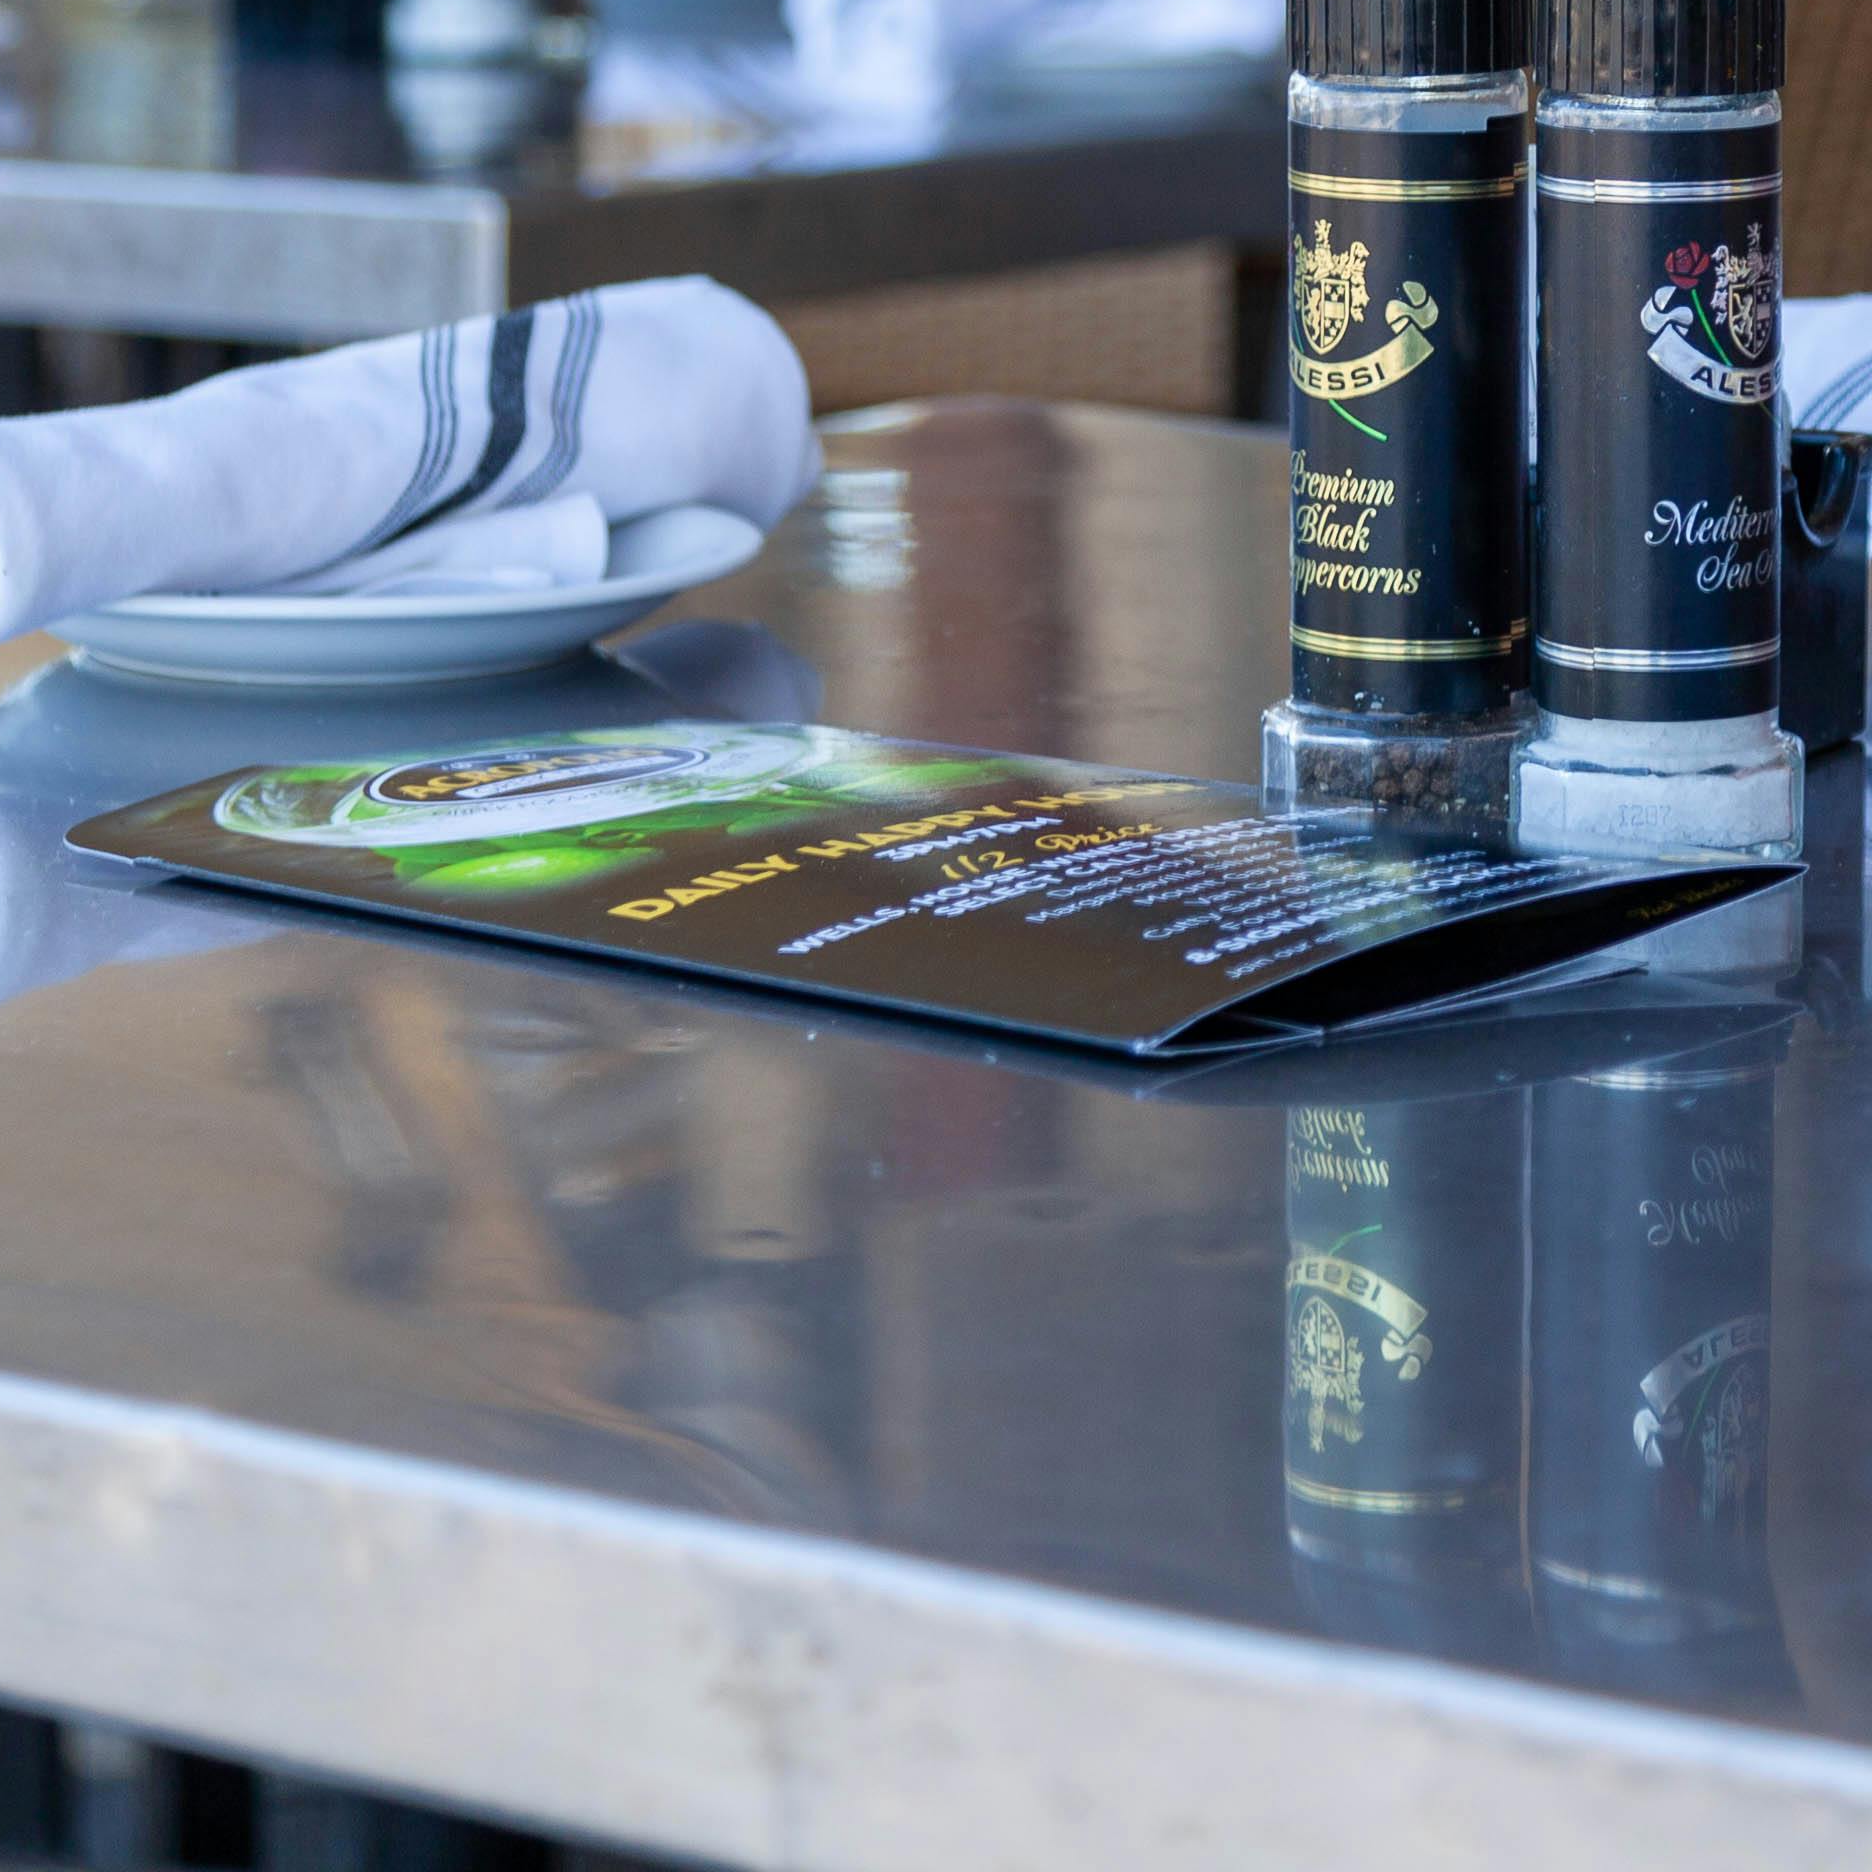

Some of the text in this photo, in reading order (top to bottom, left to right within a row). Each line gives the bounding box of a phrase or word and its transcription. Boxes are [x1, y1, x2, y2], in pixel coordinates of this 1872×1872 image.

[1690, 364, 1782, 398] ALES
[1290, 449, 1395, 506] Premium
[1296, 503, 1377, 554] Black
[1292, 555, 1422, 596] ppercorns
[1696, 541, 1753, 593] Sea
[606, 781, 1210, 922] DAILY HAPPY HOUR
[873, 815, 1065, 863] 3PM-7PM
[940, 821, 1164, 881] 1/2 Price
[776, 905, 923, 956] WELLS,
[912, 868, 1038, 909] HOUSE
[1032, 839, 1163, 871] WINES,
[1152, 816, 1267, 842] DRAFT
[932, 875, 1063, 918] SELECT
[1063, 852, 1161, 880] CALL
[1025, 869, 1204, 925] Margaritaville
[1045, 876, 1124, 901] Deep
[1119, 855, 1198, 880] Eddy
[1132, 879, 1226, 907] Mount
[1184, 886, 1244, 906] Van
[1141, 911, 1224, 941] Cutty
[1183, 948, 1221, 966] &
[1214, 891, 1408, 954] SIGNATURE
[1218, 908, 1289, 933] Four
